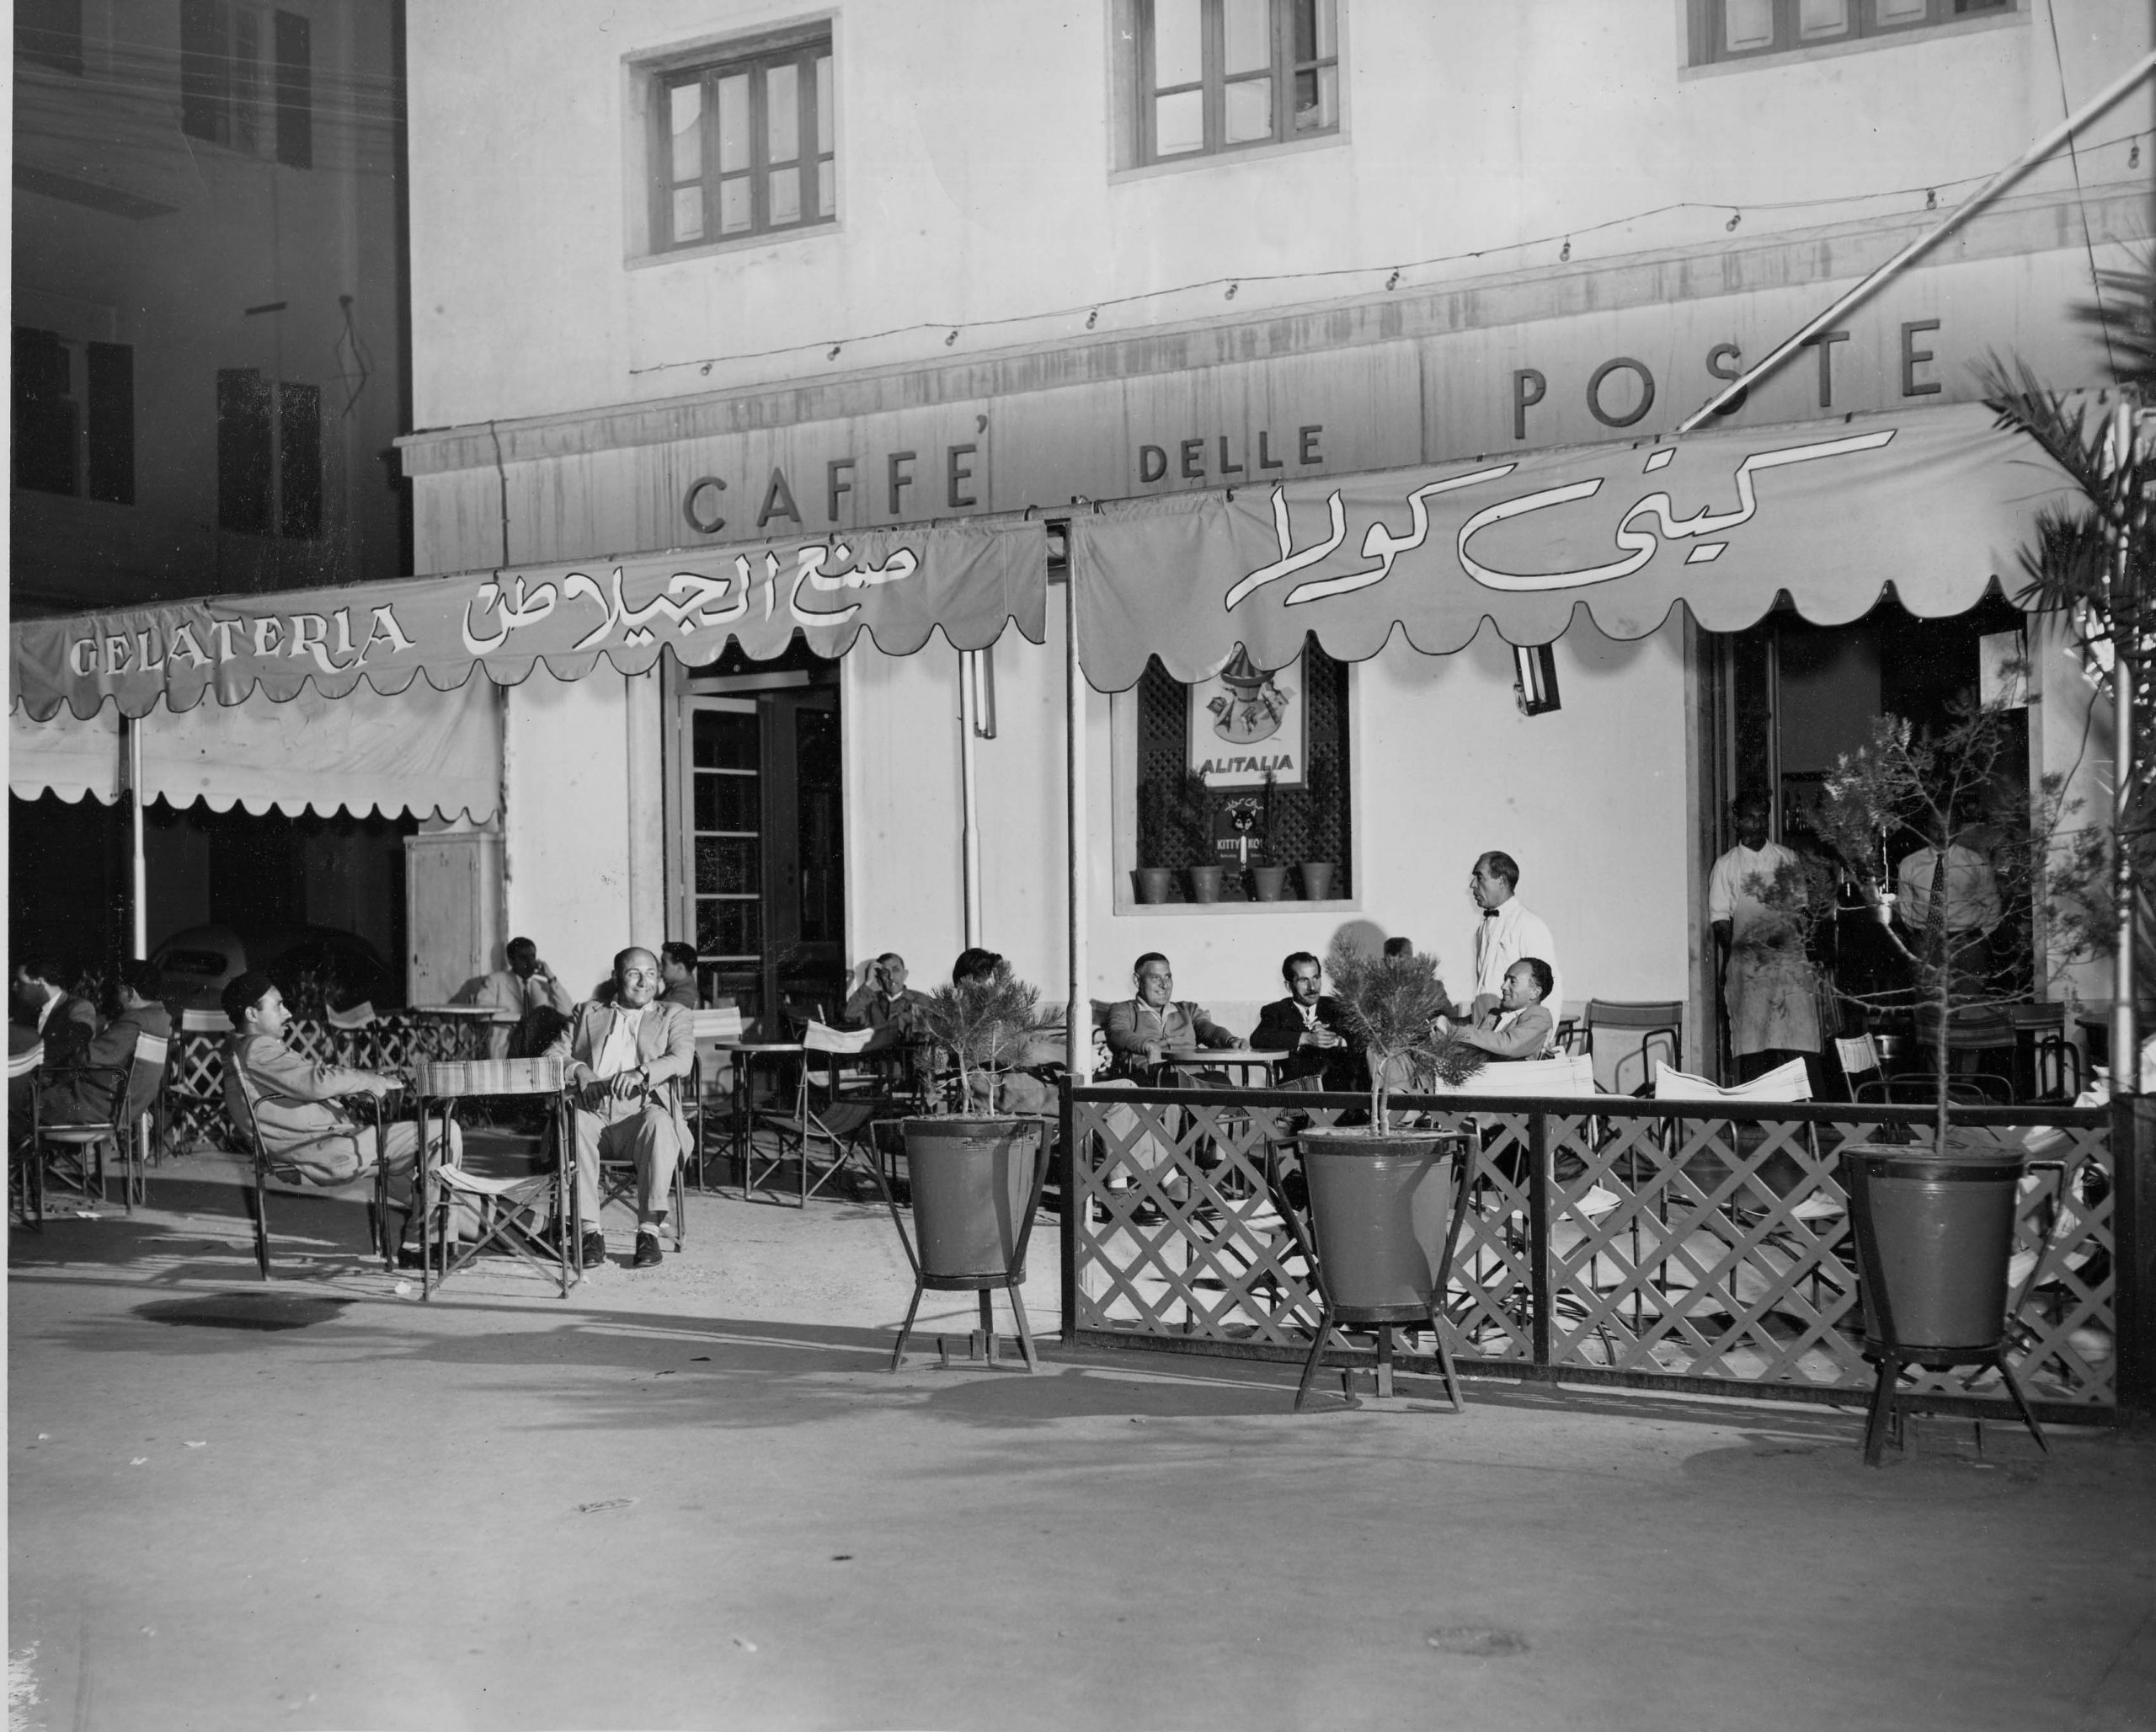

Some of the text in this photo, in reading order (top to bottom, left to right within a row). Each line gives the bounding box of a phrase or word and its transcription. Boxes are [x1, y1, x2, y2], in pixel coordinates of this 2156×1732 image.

[1139, 425, 1323, 483] DELLE
[1513, 318, 1941, 439] POSTE
[1225, 462, 1518, 612] كولا
[70, 602, 416, 676] GELATERIA
[1199, 755, 1294, 774] ALITALIA
[1217, 839, 1241, 850] KITTY
